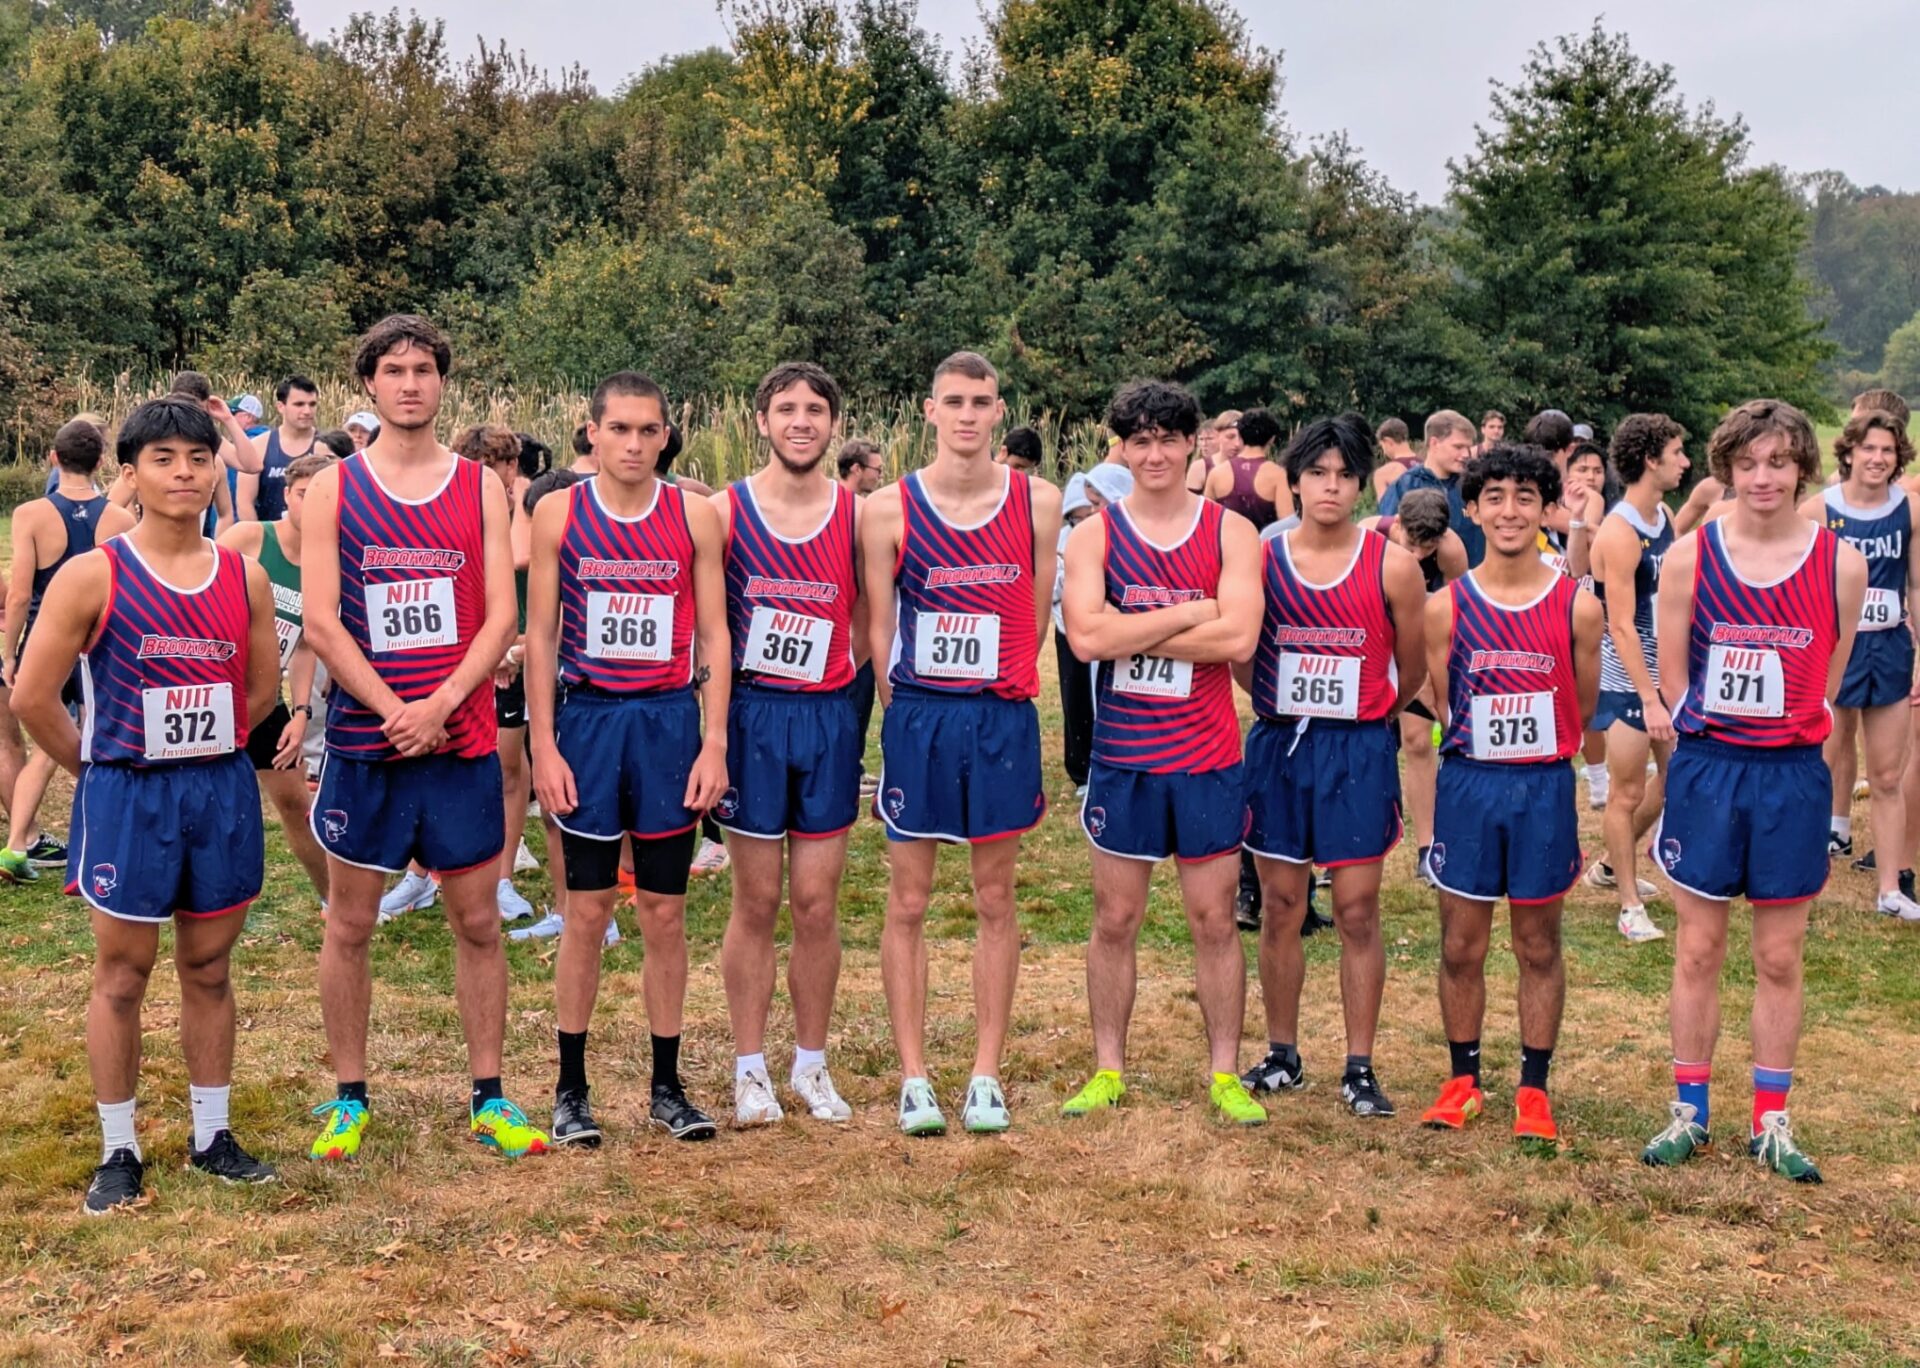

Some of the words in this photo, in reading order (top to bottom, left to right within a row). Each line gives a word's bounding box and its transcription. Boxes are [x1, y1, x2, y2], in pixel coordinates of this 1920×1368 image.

[362, 547, 464, 570] BROOKDALE
[579, 558, 678, 579] BROOKDALE
[926, 565, 1020, 589] BROOKDALE
[386, 582, 433, 604] NJIT
[746, 577, 838, 602] BROOKDALE
[607, 595, 654, 615] NJIT
[1863, 604, 1889, 622] 49
[382, 604, 442, 636] 366
[769, 613, 816, 636] NJIT
[935, 615, 981, 634] NJIT
[386, 634, 445, 649] Invitational
[601, 617, 657, 646] 368
[1275, 626, 1365, 646] BROOKDALE
[1712, 624, 1813, 648] BROOKDALE
[139, 635, 237, 660] BROOKDALE
[600, 647, 658, 659] Invitational
[762, 633, 813, 667] 367
[932, 636, 981, 665] 370
[756, 661, 811, 680] Invitational
[927, 665, 985, 677] Invitational
[1130, 653, 1174, 683] 374
[1298, 657, 1340, 675] NJIT
[1469, 651, 1555, 673] BROOKDALE
[1723, 651, 1765, 671] NJIT
[1124, 682, 1177, 695] Invitational
[1291, 678, 1344, 705] 365
[1720, 671, 1764, 703] 371
[165, 687, 212, 710] NJIT
[1490, 696, 1533, 715] NJIT
[1713, 702, 1770, 717] Invitational
[1289, 704, 1345, 716] Invitational
[164, 711, 217, 744] 372
[1488, 716, 1538, 746] 373
[162, 743, 222, 759] Invitational
[1487, 745, 1543, 758] Invitational
